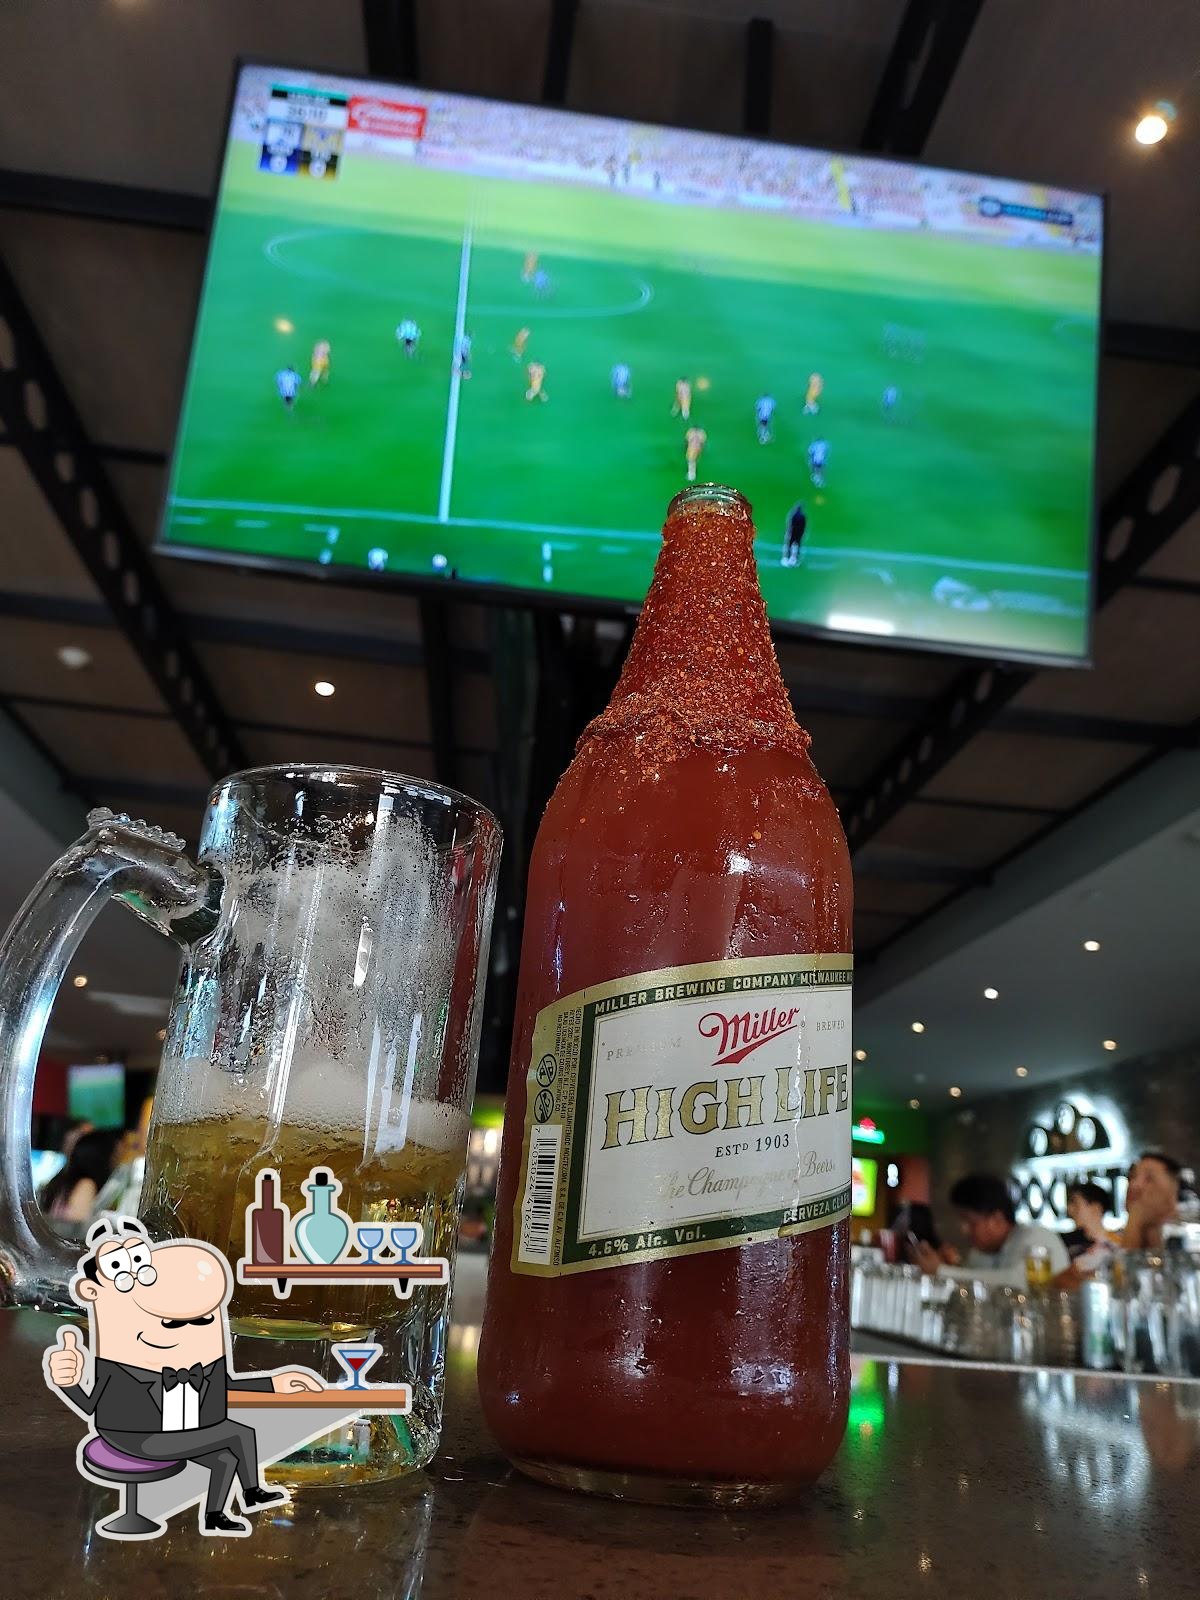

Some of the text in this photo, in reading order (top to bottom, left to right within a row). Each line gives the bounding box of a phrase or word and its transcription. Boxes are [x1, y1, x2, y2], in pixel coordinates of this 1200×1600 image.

[595, 991, 648, 1015] MILLER
[655, 977, 726, 1001] BREWING
[733, 973, 796, 990] COMPANY
[800, 971, 846, 986] MILWAUKEE
[698, 1007, 800, 1067] Miller
[600, 1063, 848, 1150] HIGH LIFE
[755, 1133, 790, 1152] 1903
[783, 1199, 831, 1224] CERVEZA
[588, 1237, 630, 1257] 4.6%
[674, 1225, 706, 1243] Vol.
